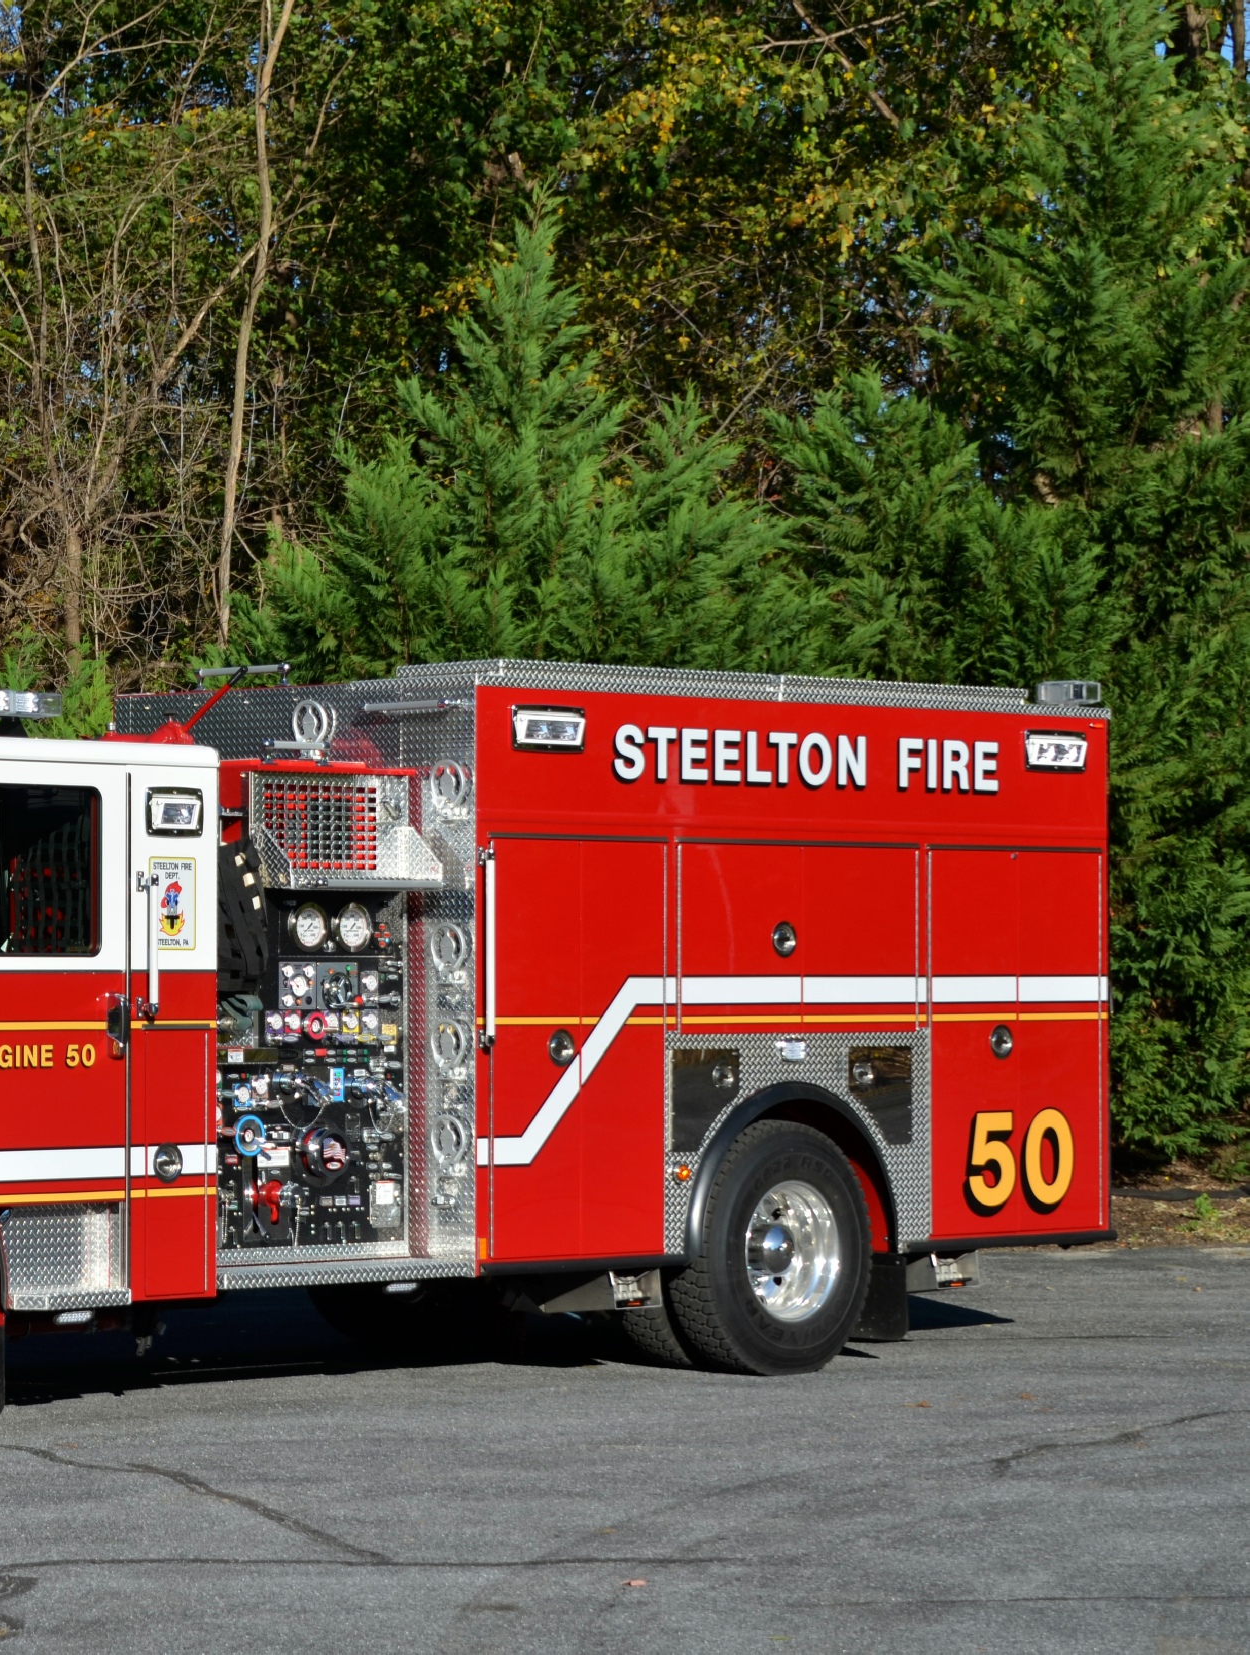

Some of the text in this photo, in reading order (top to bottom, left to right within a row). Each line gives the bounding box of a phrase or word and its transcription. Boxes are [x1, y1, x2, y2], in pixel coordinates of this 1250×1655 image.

[613, 723, 999, 793] STEELTON FIRE
[153, 862, 192, 871] STEELTON FIRE
[165, 872, 180, 880] DEPT.
[65, 1043, 96, 1068] 50
[963, 1107, 1075, 1217] 50
